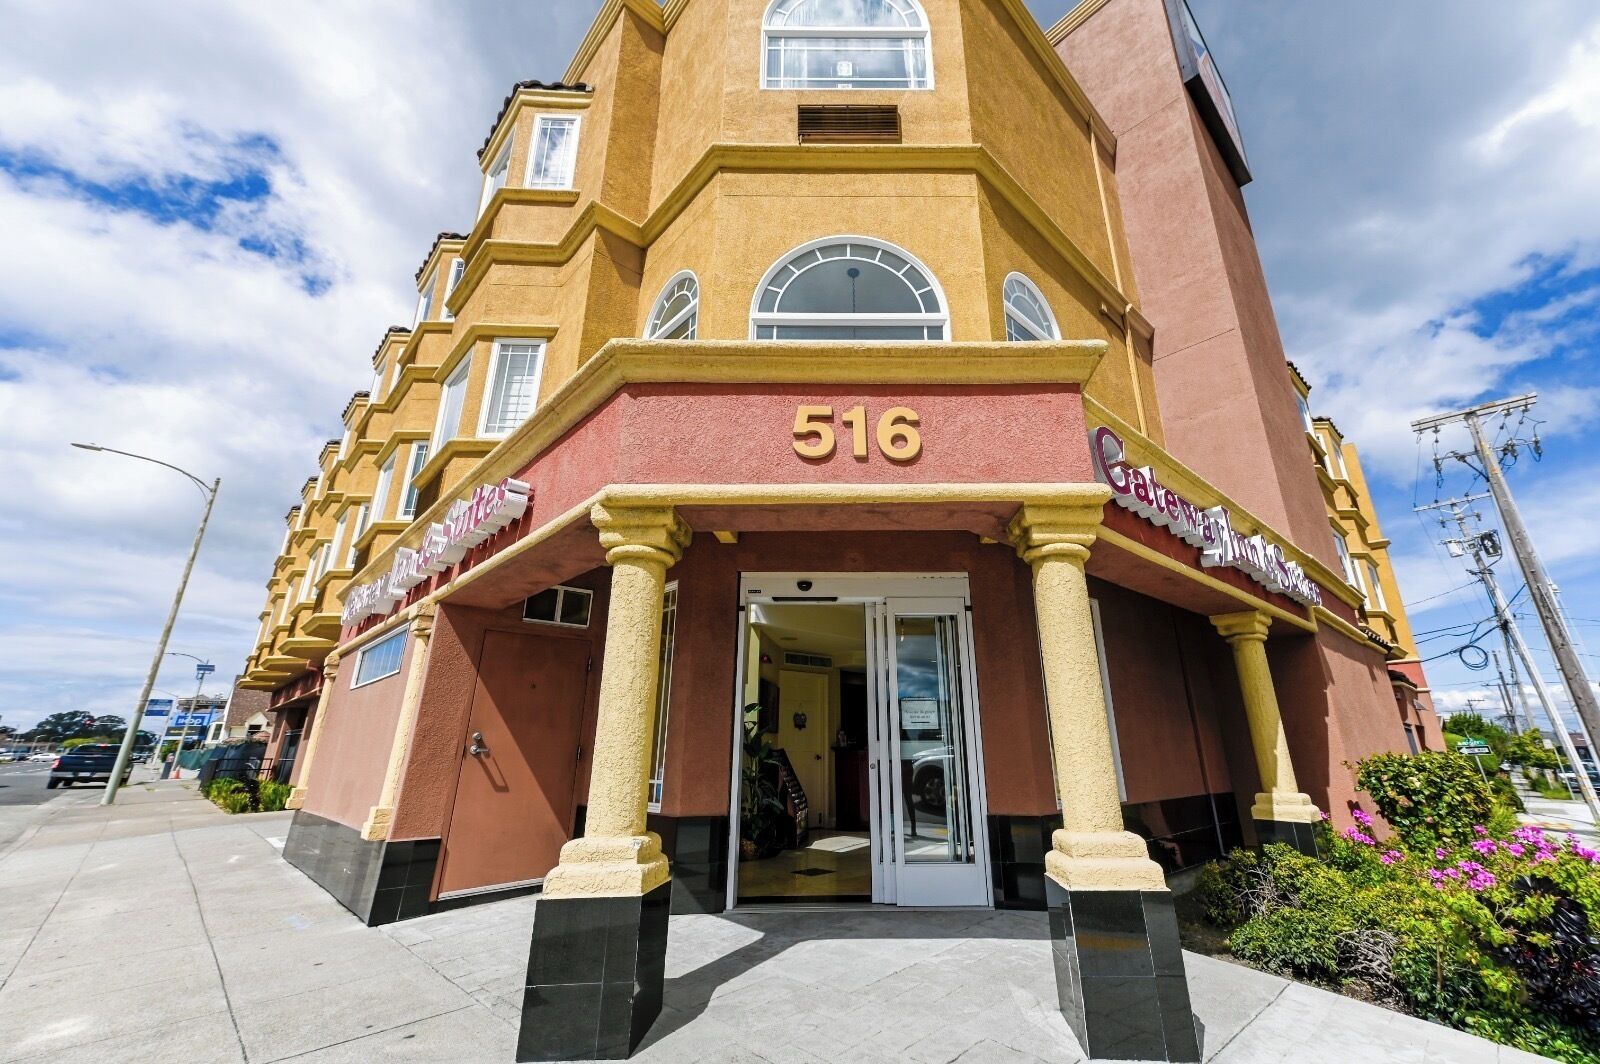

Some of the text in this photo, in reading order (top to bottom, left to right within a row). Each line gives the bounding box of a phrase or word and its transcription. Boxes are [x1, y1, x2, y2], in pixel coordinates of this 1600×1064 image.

[792, 405, 921, 461] 516
[1093, 426, 1226, 567] Gateway
[1221, 505, 1266, 573] Inn
